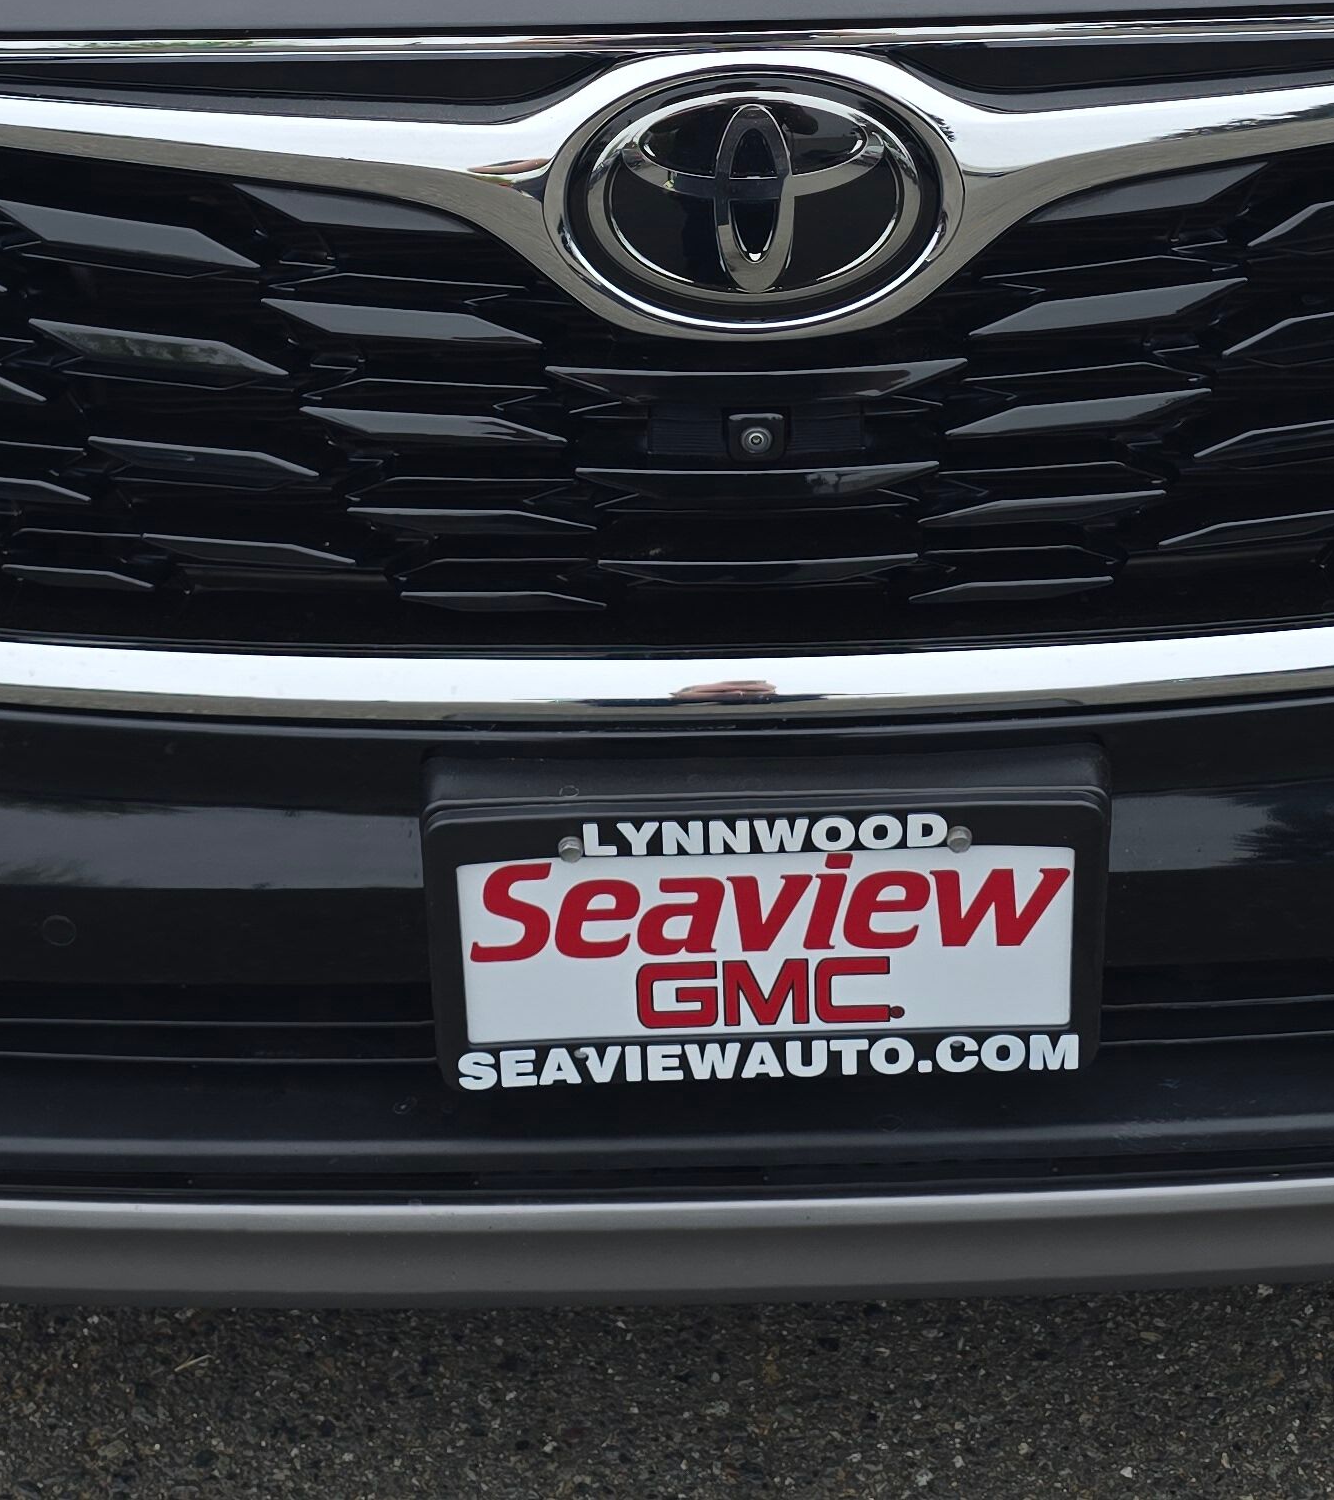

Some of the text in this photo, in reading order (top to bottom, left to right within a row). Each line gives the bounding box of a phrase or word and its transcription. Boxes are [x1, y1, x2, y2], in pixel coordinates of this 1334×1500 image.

[582, 813, 948, 857] LYNNWOOD
[470, 853, 1071, 963] Seaview
[636, 956, 905, 1029] GMC
[457, 1034, 1081, 1091] SEAVIEWAUTO.COM
